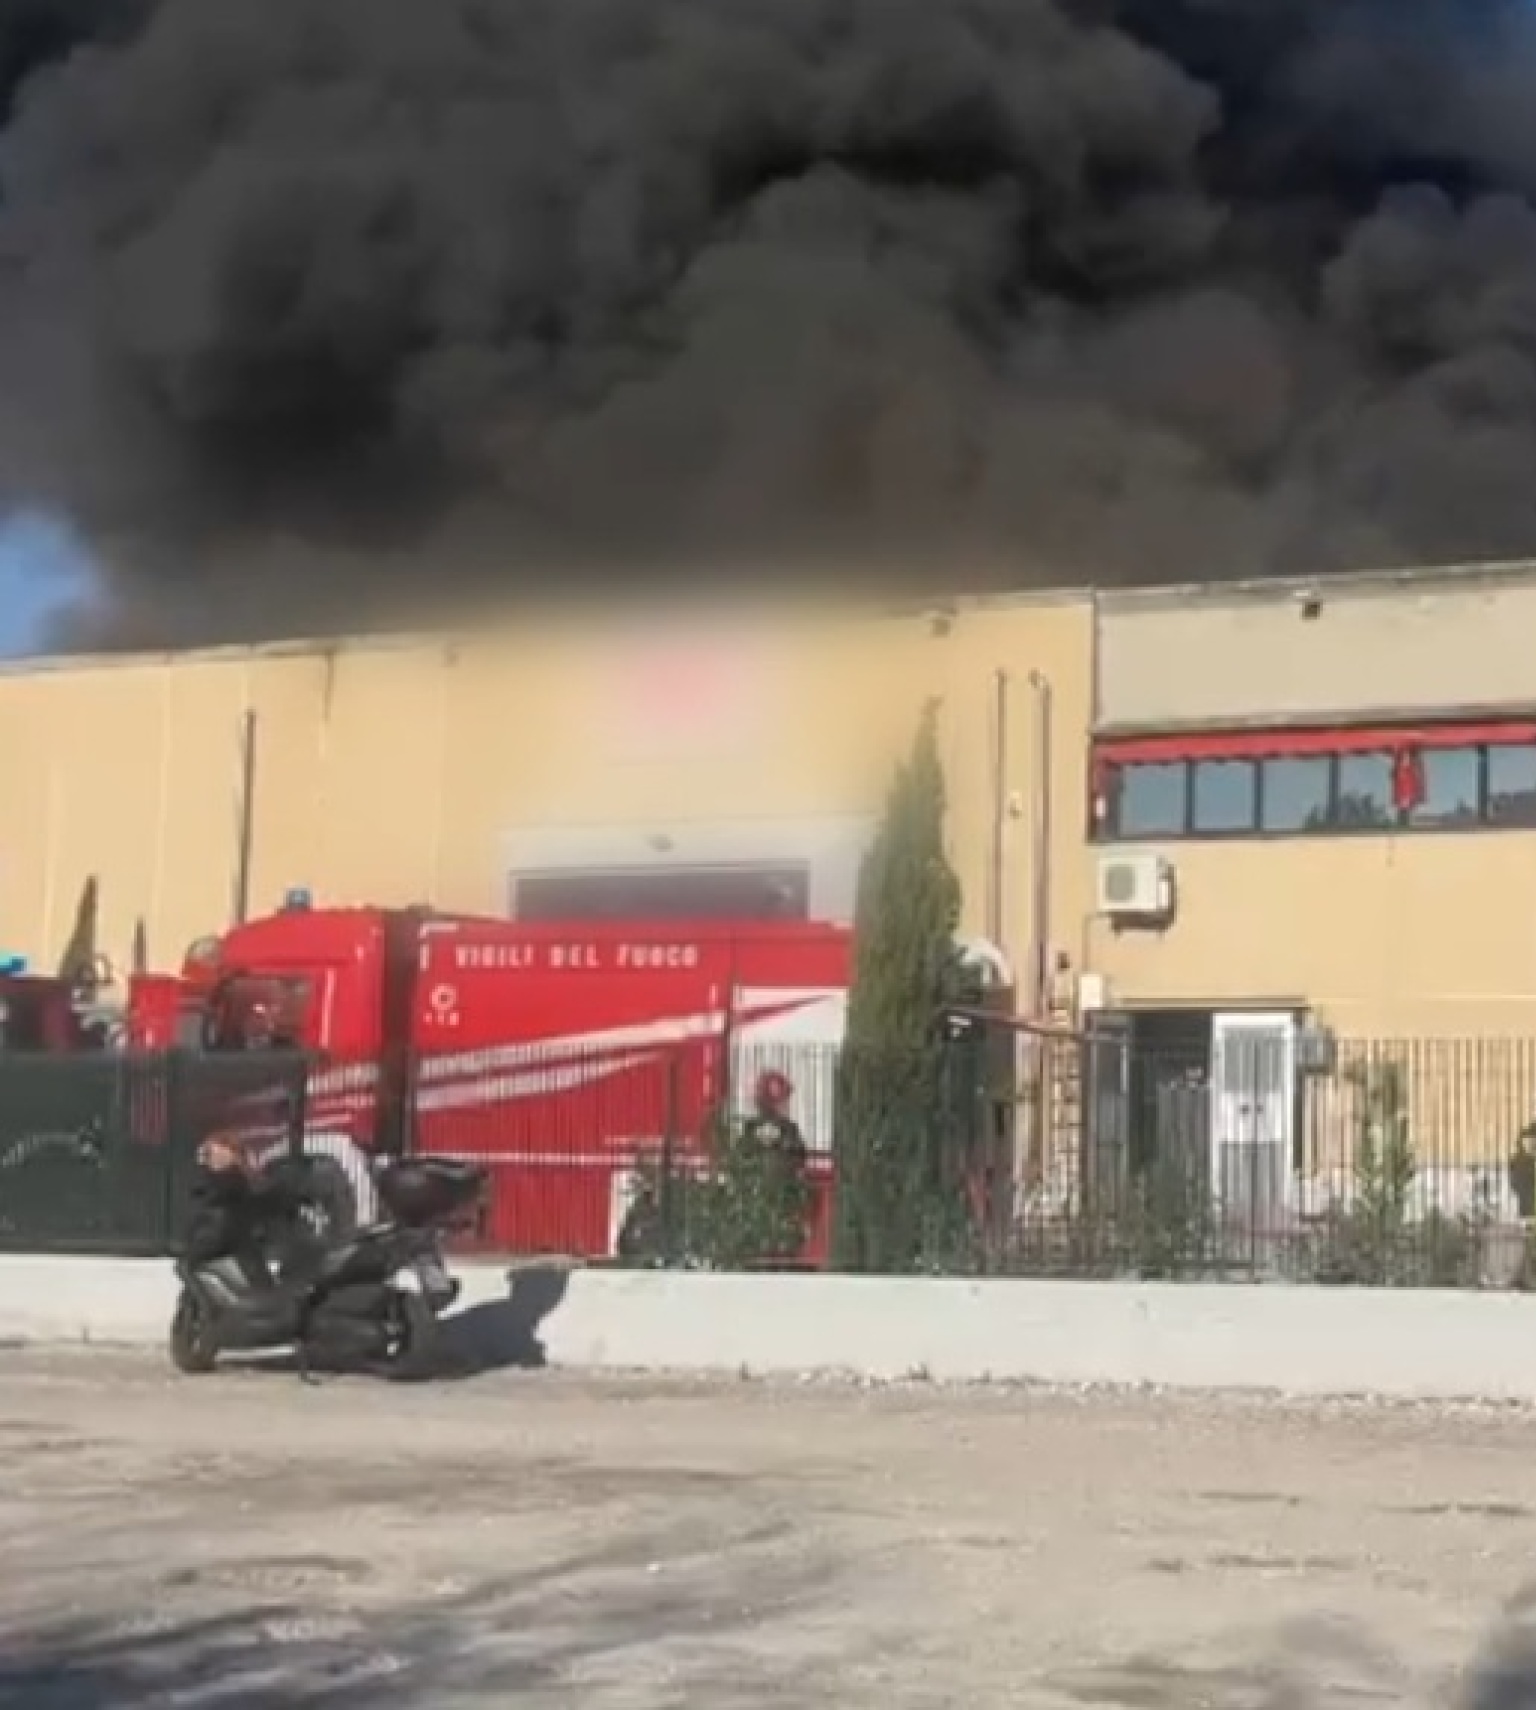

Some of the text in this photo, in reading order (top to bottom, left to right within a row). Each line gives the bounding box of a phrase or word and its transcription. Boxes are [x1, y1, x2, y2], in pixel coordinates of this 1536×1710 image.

[455, 943, 698, 968] VIGILI DEL FUOCO
